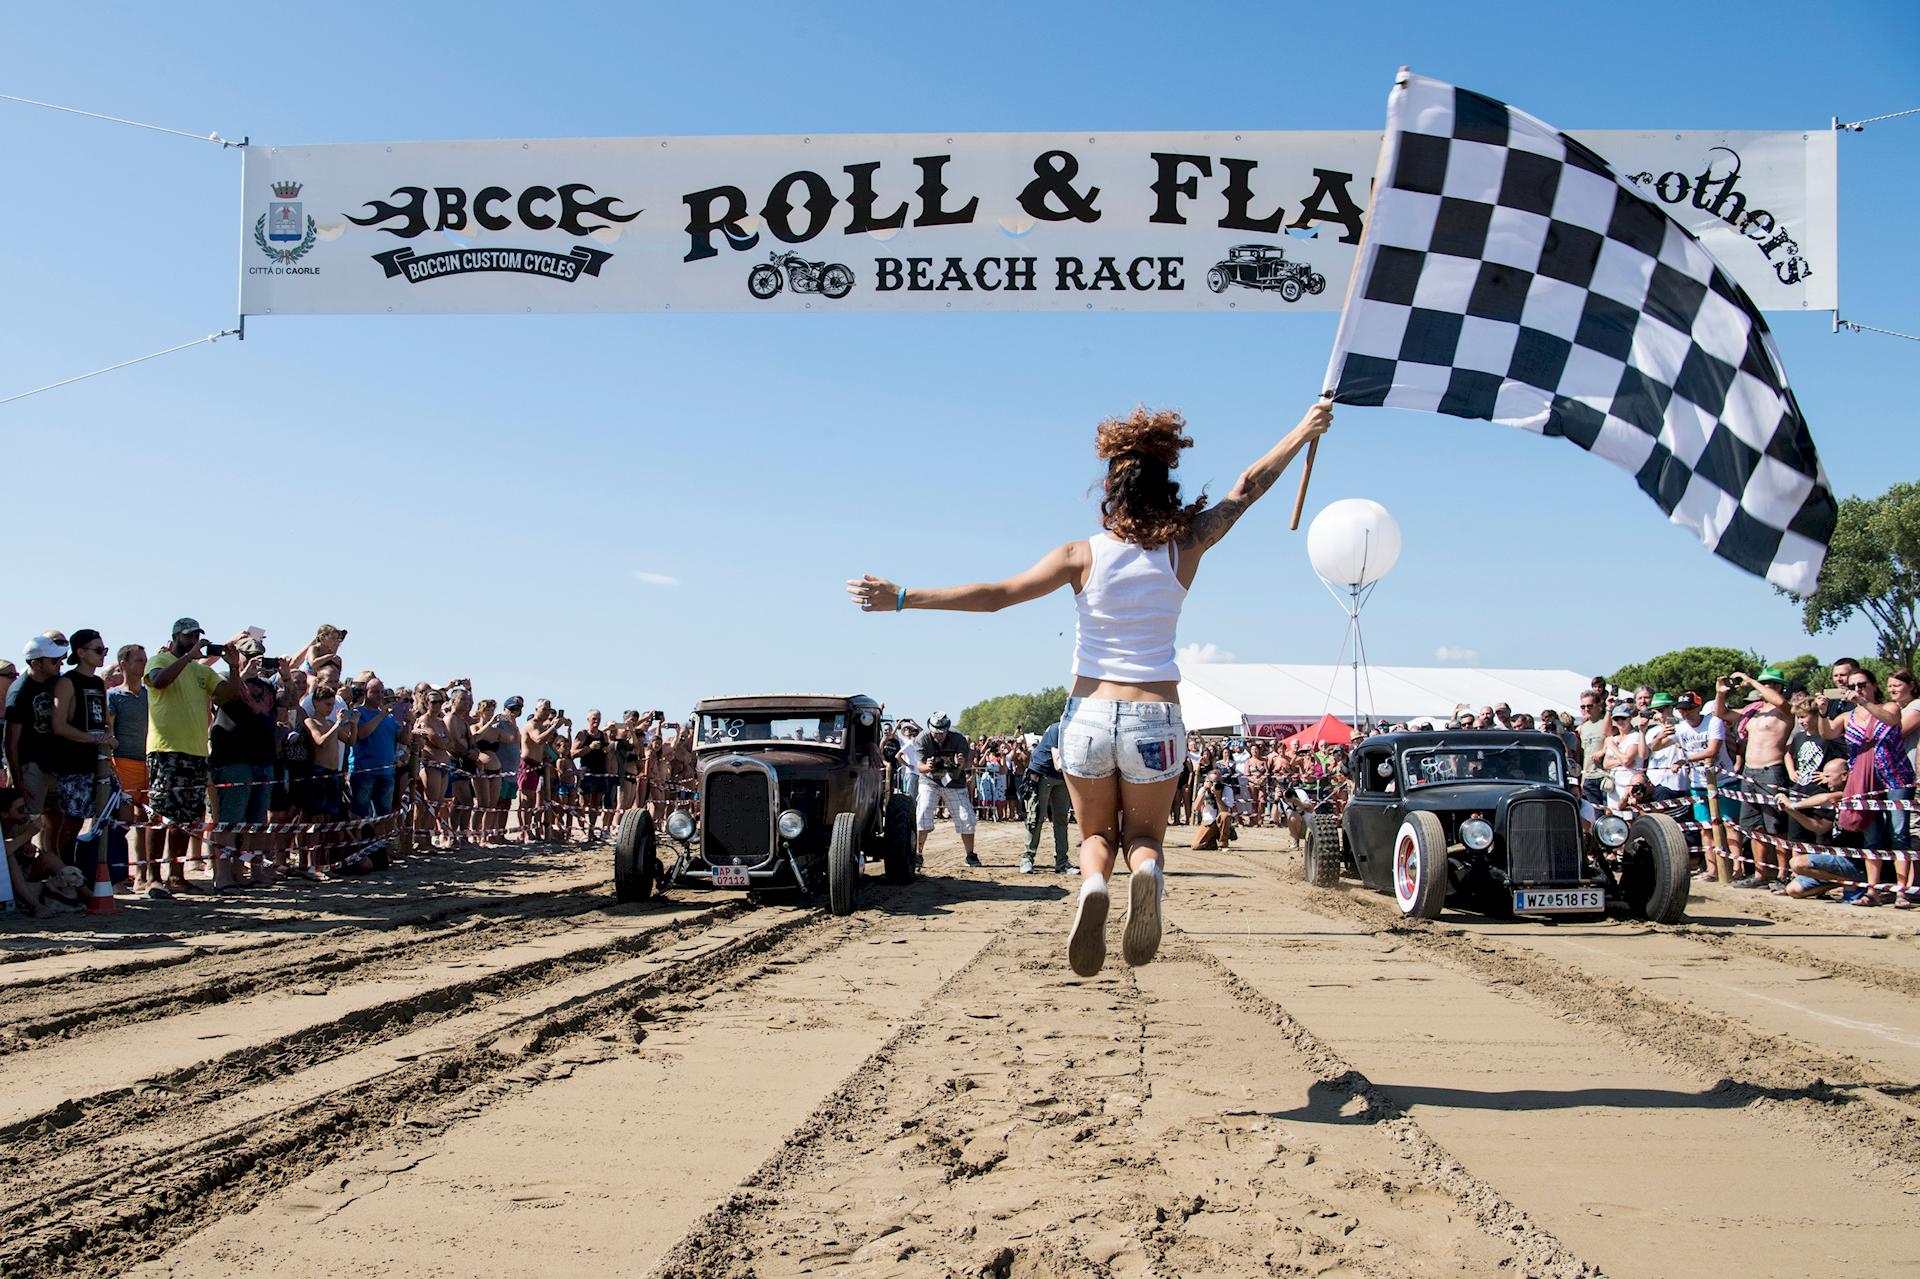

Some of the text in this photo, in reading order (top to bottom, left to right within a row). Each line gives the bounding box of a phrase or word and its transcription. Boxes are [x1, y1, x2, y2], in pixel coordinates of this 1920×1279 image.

[682, 150, 1376, 264] ROLL & FLA
[275, 267, 284, 275] DI
[285, 267, 321, 275] CAORLE
[408, 251, 577, 280] BOCCIN CUSTOM CYCLES
[875, 256, 1185, 292] BEACH RACE
[720, 867, 731, 876] AP
[1527, 892, 1599, 907] WZ 518 FS
